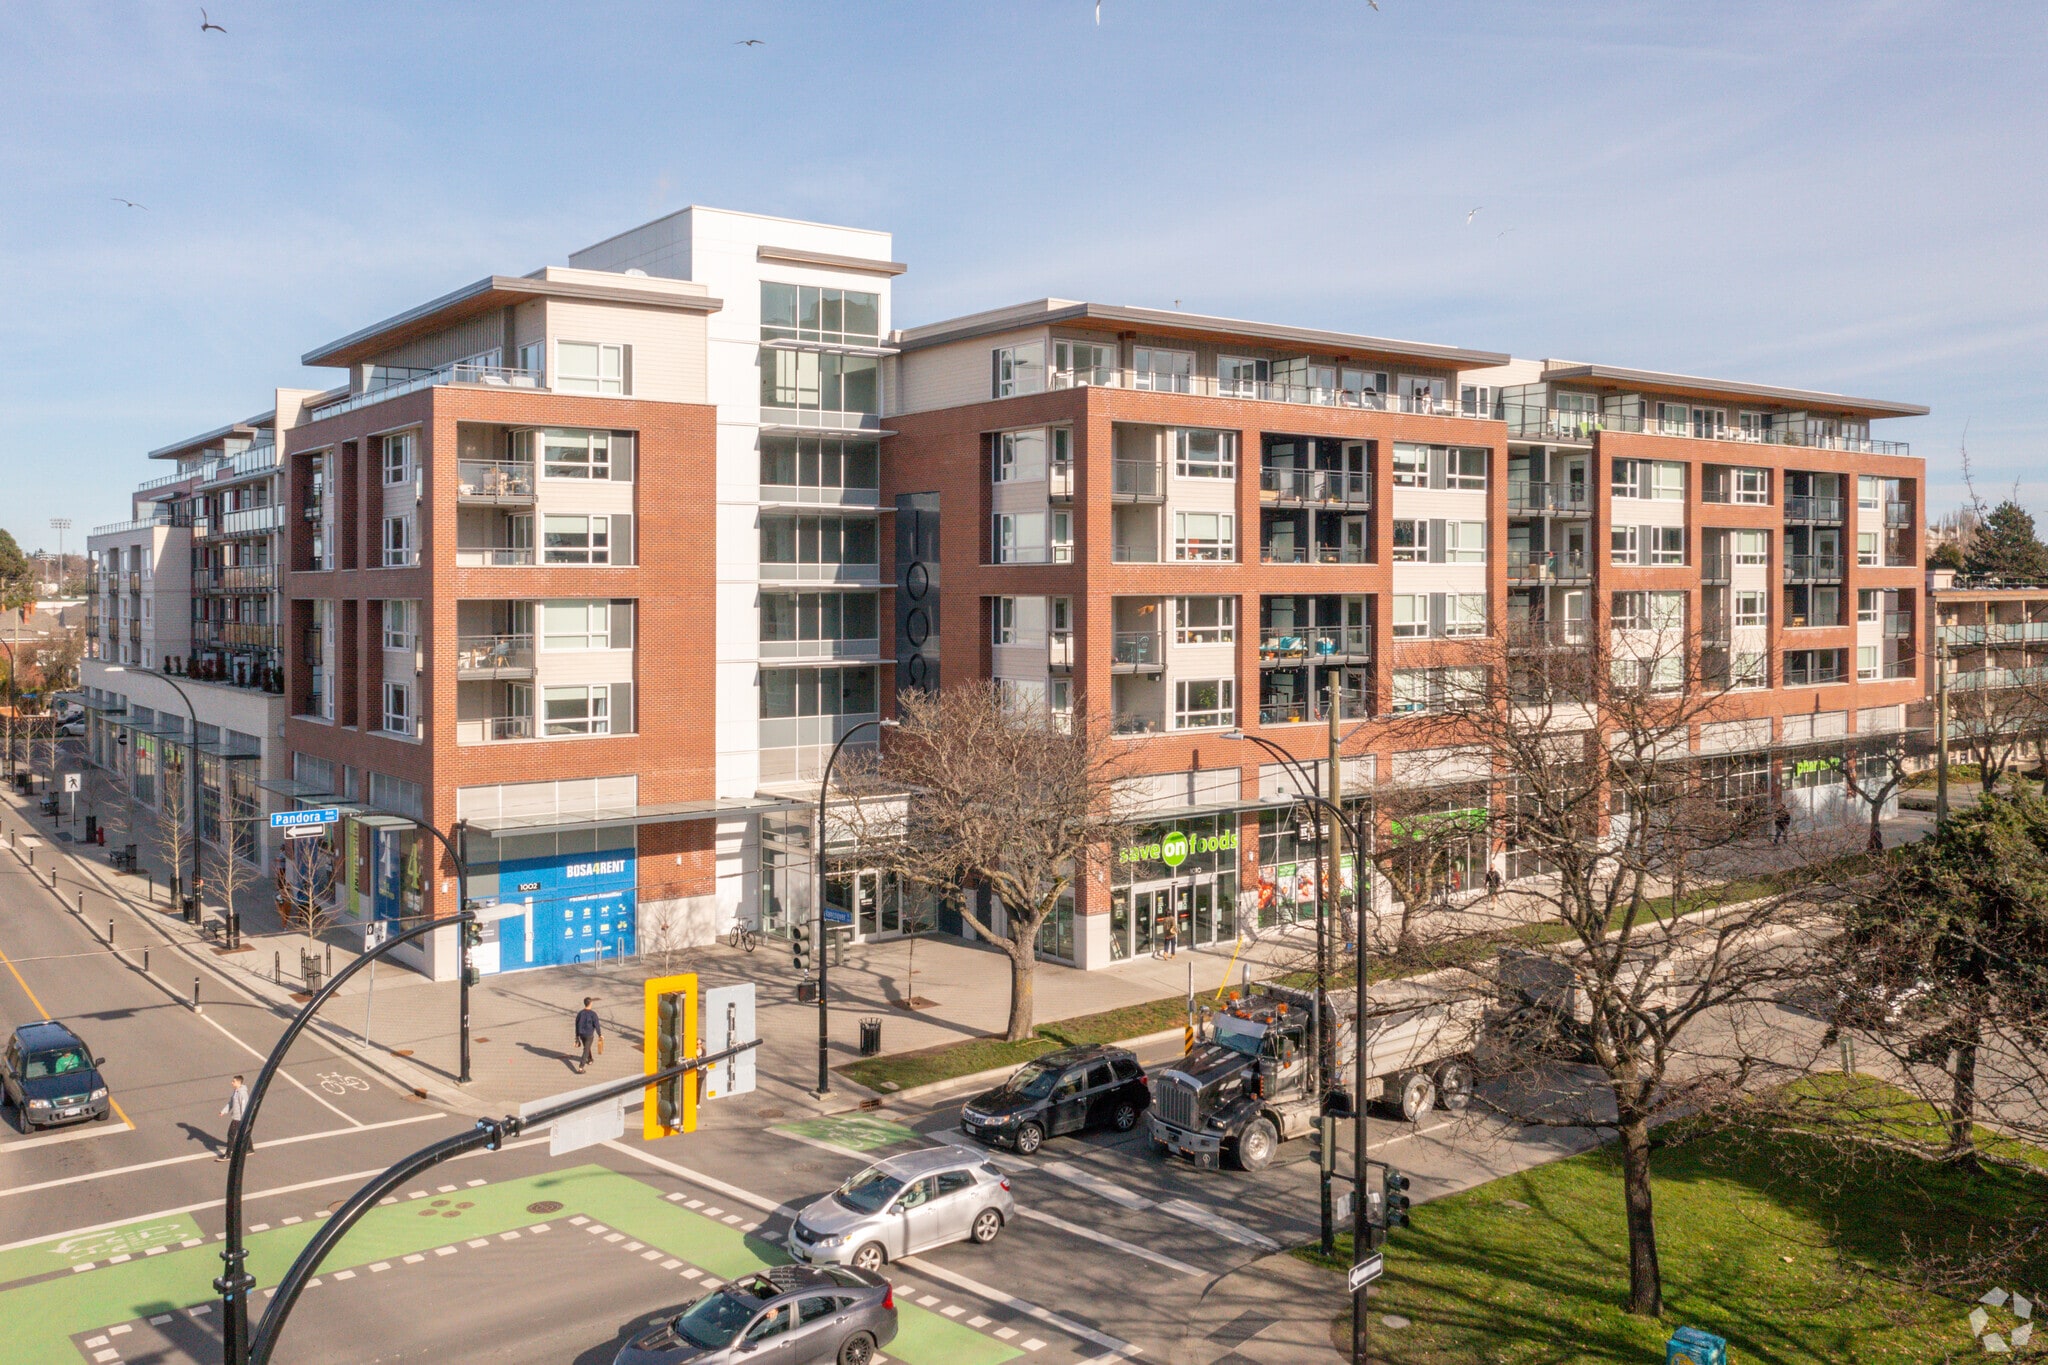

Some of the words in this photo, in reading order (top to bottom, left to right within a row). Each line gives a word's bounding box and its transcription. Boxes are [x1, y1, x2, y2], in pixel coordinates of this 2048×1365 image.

[276, 813, 320, 824] Pandora
[1119, 843, 1161, 863] save
[1164, 840, 1186, 858] on
[1189, 829, 1239, 855] foods
[566, 860, 626, 878] BOSA4RENT
[520, 882, 538, 891] 1002
